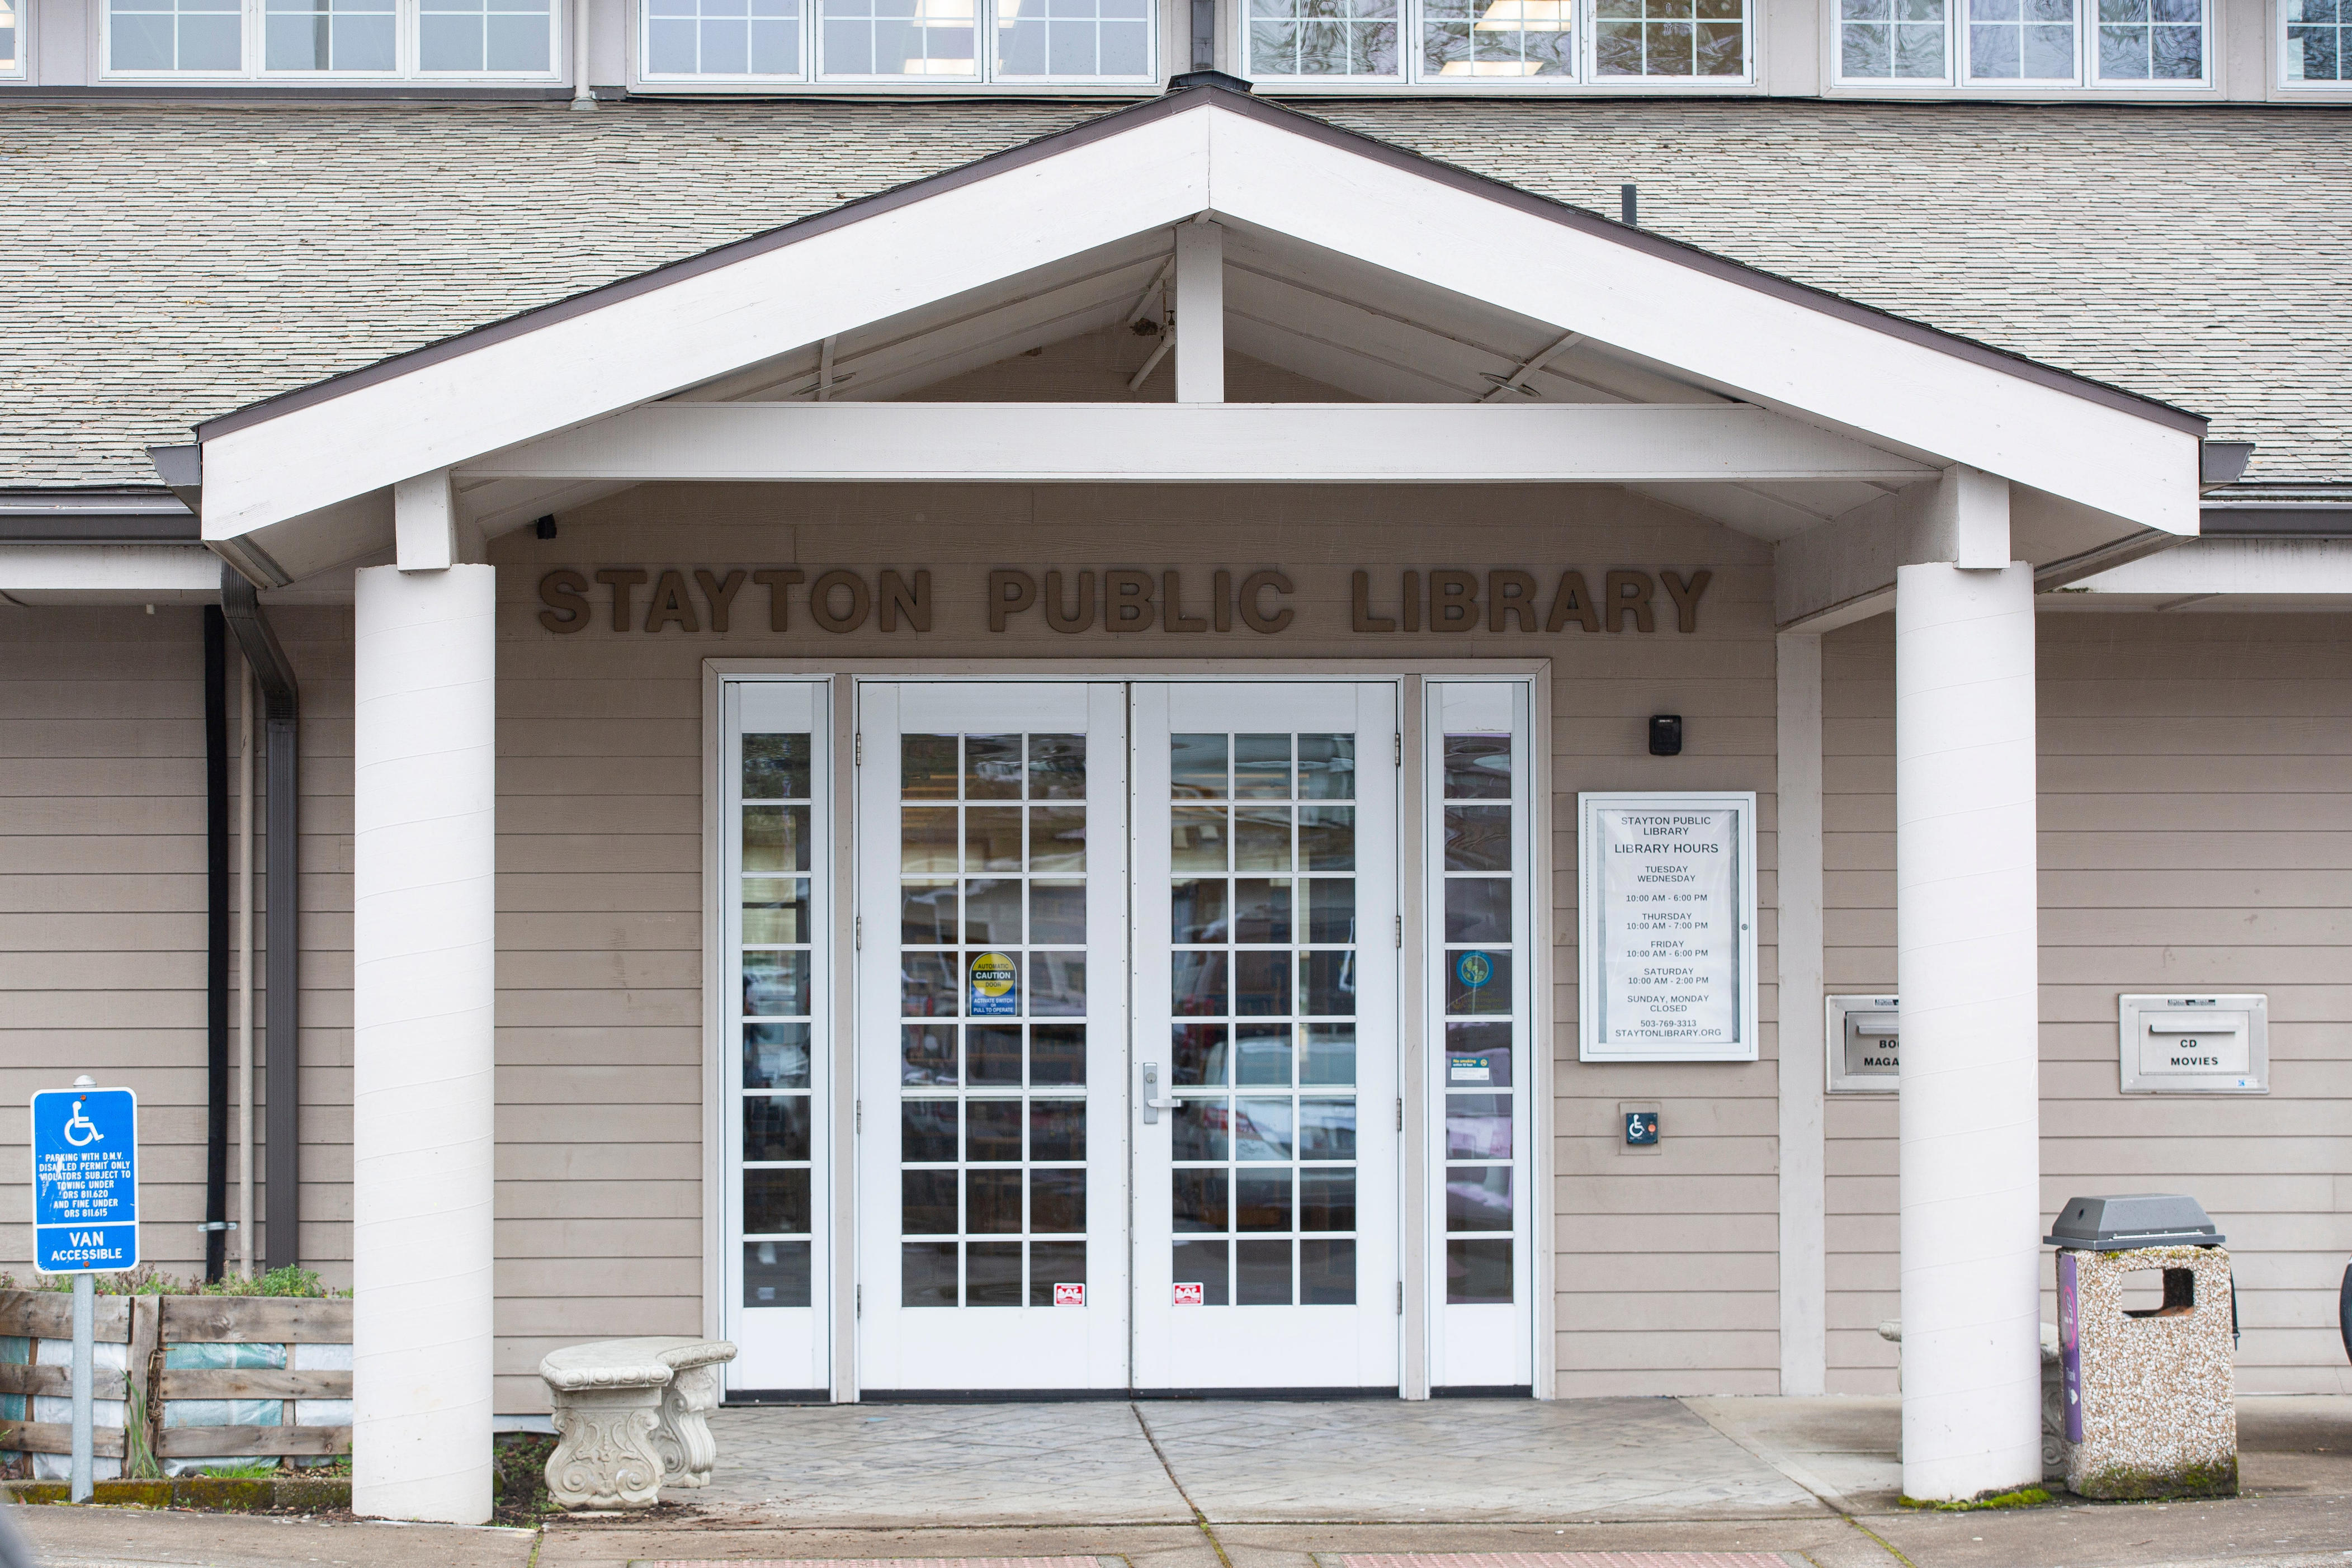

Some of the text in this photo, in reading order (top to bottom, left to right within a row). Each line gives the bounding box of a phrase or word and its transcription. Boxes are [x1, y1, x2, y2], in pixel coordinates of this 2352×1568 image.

[538, 568, 1713, 634] STAYTON PUBLIC LIBRARY
[1621, 816, 1711, 825] STAYTON PUBLIC
[1643, 827, 1689, 835] LIBRARY
[1614, 843, 1718, 853] LIBRARY HOURS
[1627, 995, 1668, 1004] SUNDAY,
[1615, 1029, 1722, 1037] STAYTONLIBRARY.ORG
[1879, 1040, 1898, 1049] BO
[2180, 1039, 2197, 1047] CD
[2170, 1057, 2219, 1066] MOVIES
[45, 1151, 124, 1162] PARKING WITH D.M.V.
[80, 1161, 108, 1171] PERMIT
[111, 1161, 131, 1170] ONLY
[40, 1170, 131, 1181] VIOLATORS SUBJECT TO
[57, 1180, 114, 1190] TOWING UNDER
[63, 1189, 108, 1199] ORS 811.620
[54, 1198, 119, 1209] AND FINE UNDER
[64, 1208, 108, 1218] ORS 811.615
[69, 1231, 104, 1247] VAN
[51, 1248, 122, 1261] ACCESSIBLE
